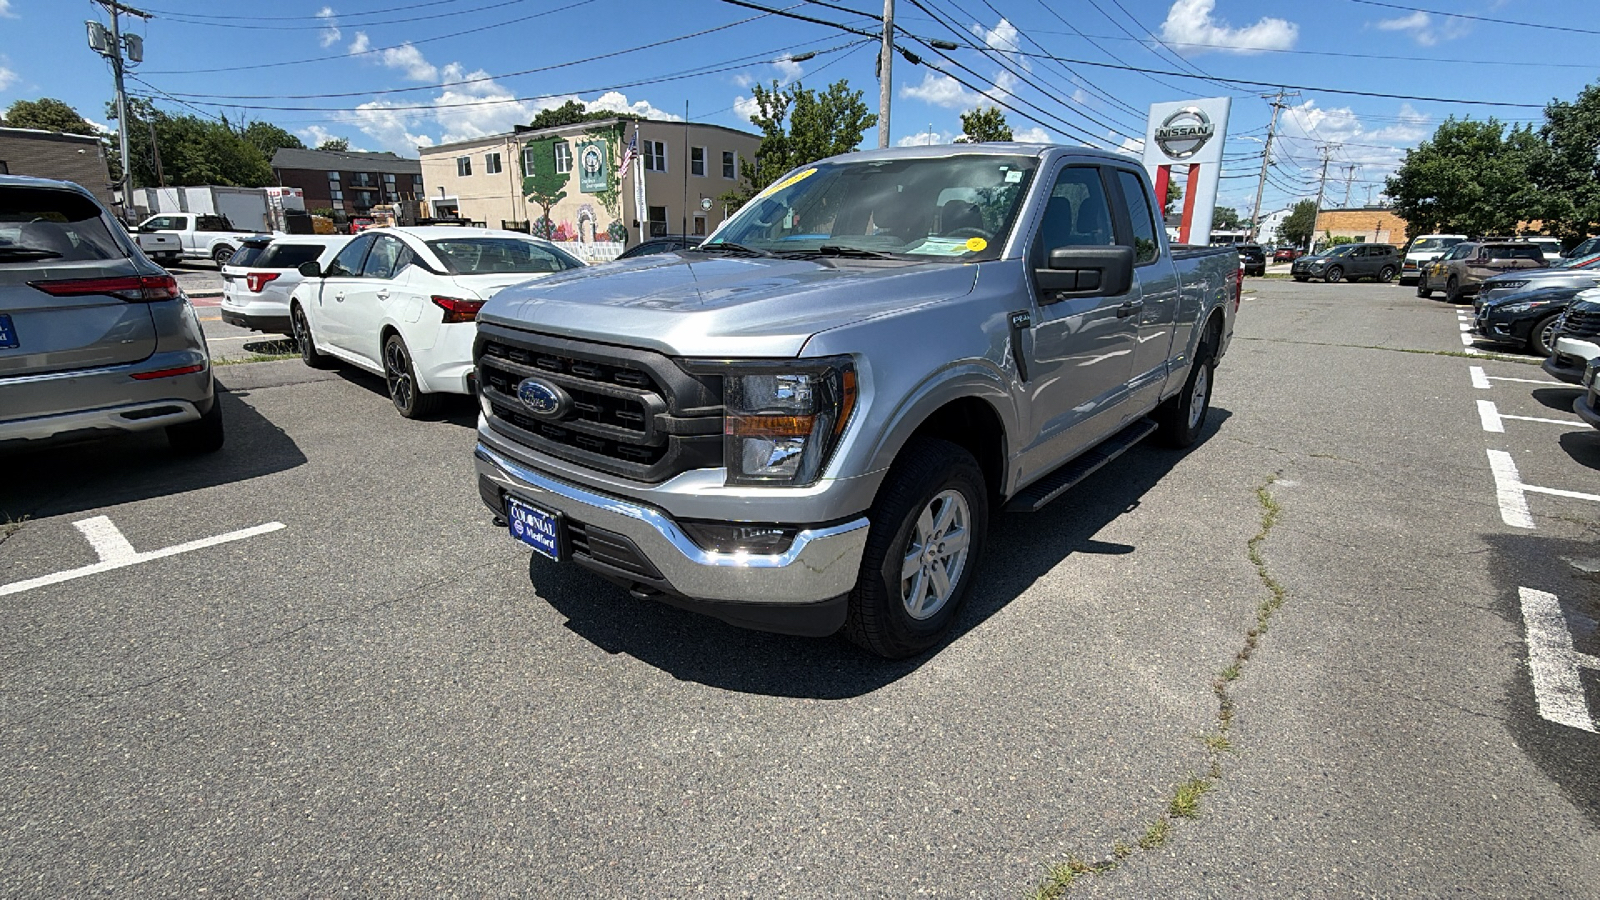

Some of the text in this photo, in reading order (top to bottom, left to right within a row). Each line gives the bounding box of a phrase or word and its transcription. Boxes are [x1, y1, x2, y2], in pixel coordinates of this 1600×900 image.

[1159, 126, 1208, 137] NISSAN
[511, 506, 556, 537] COLONIAL
[526, 526, 555, 549] Medford
